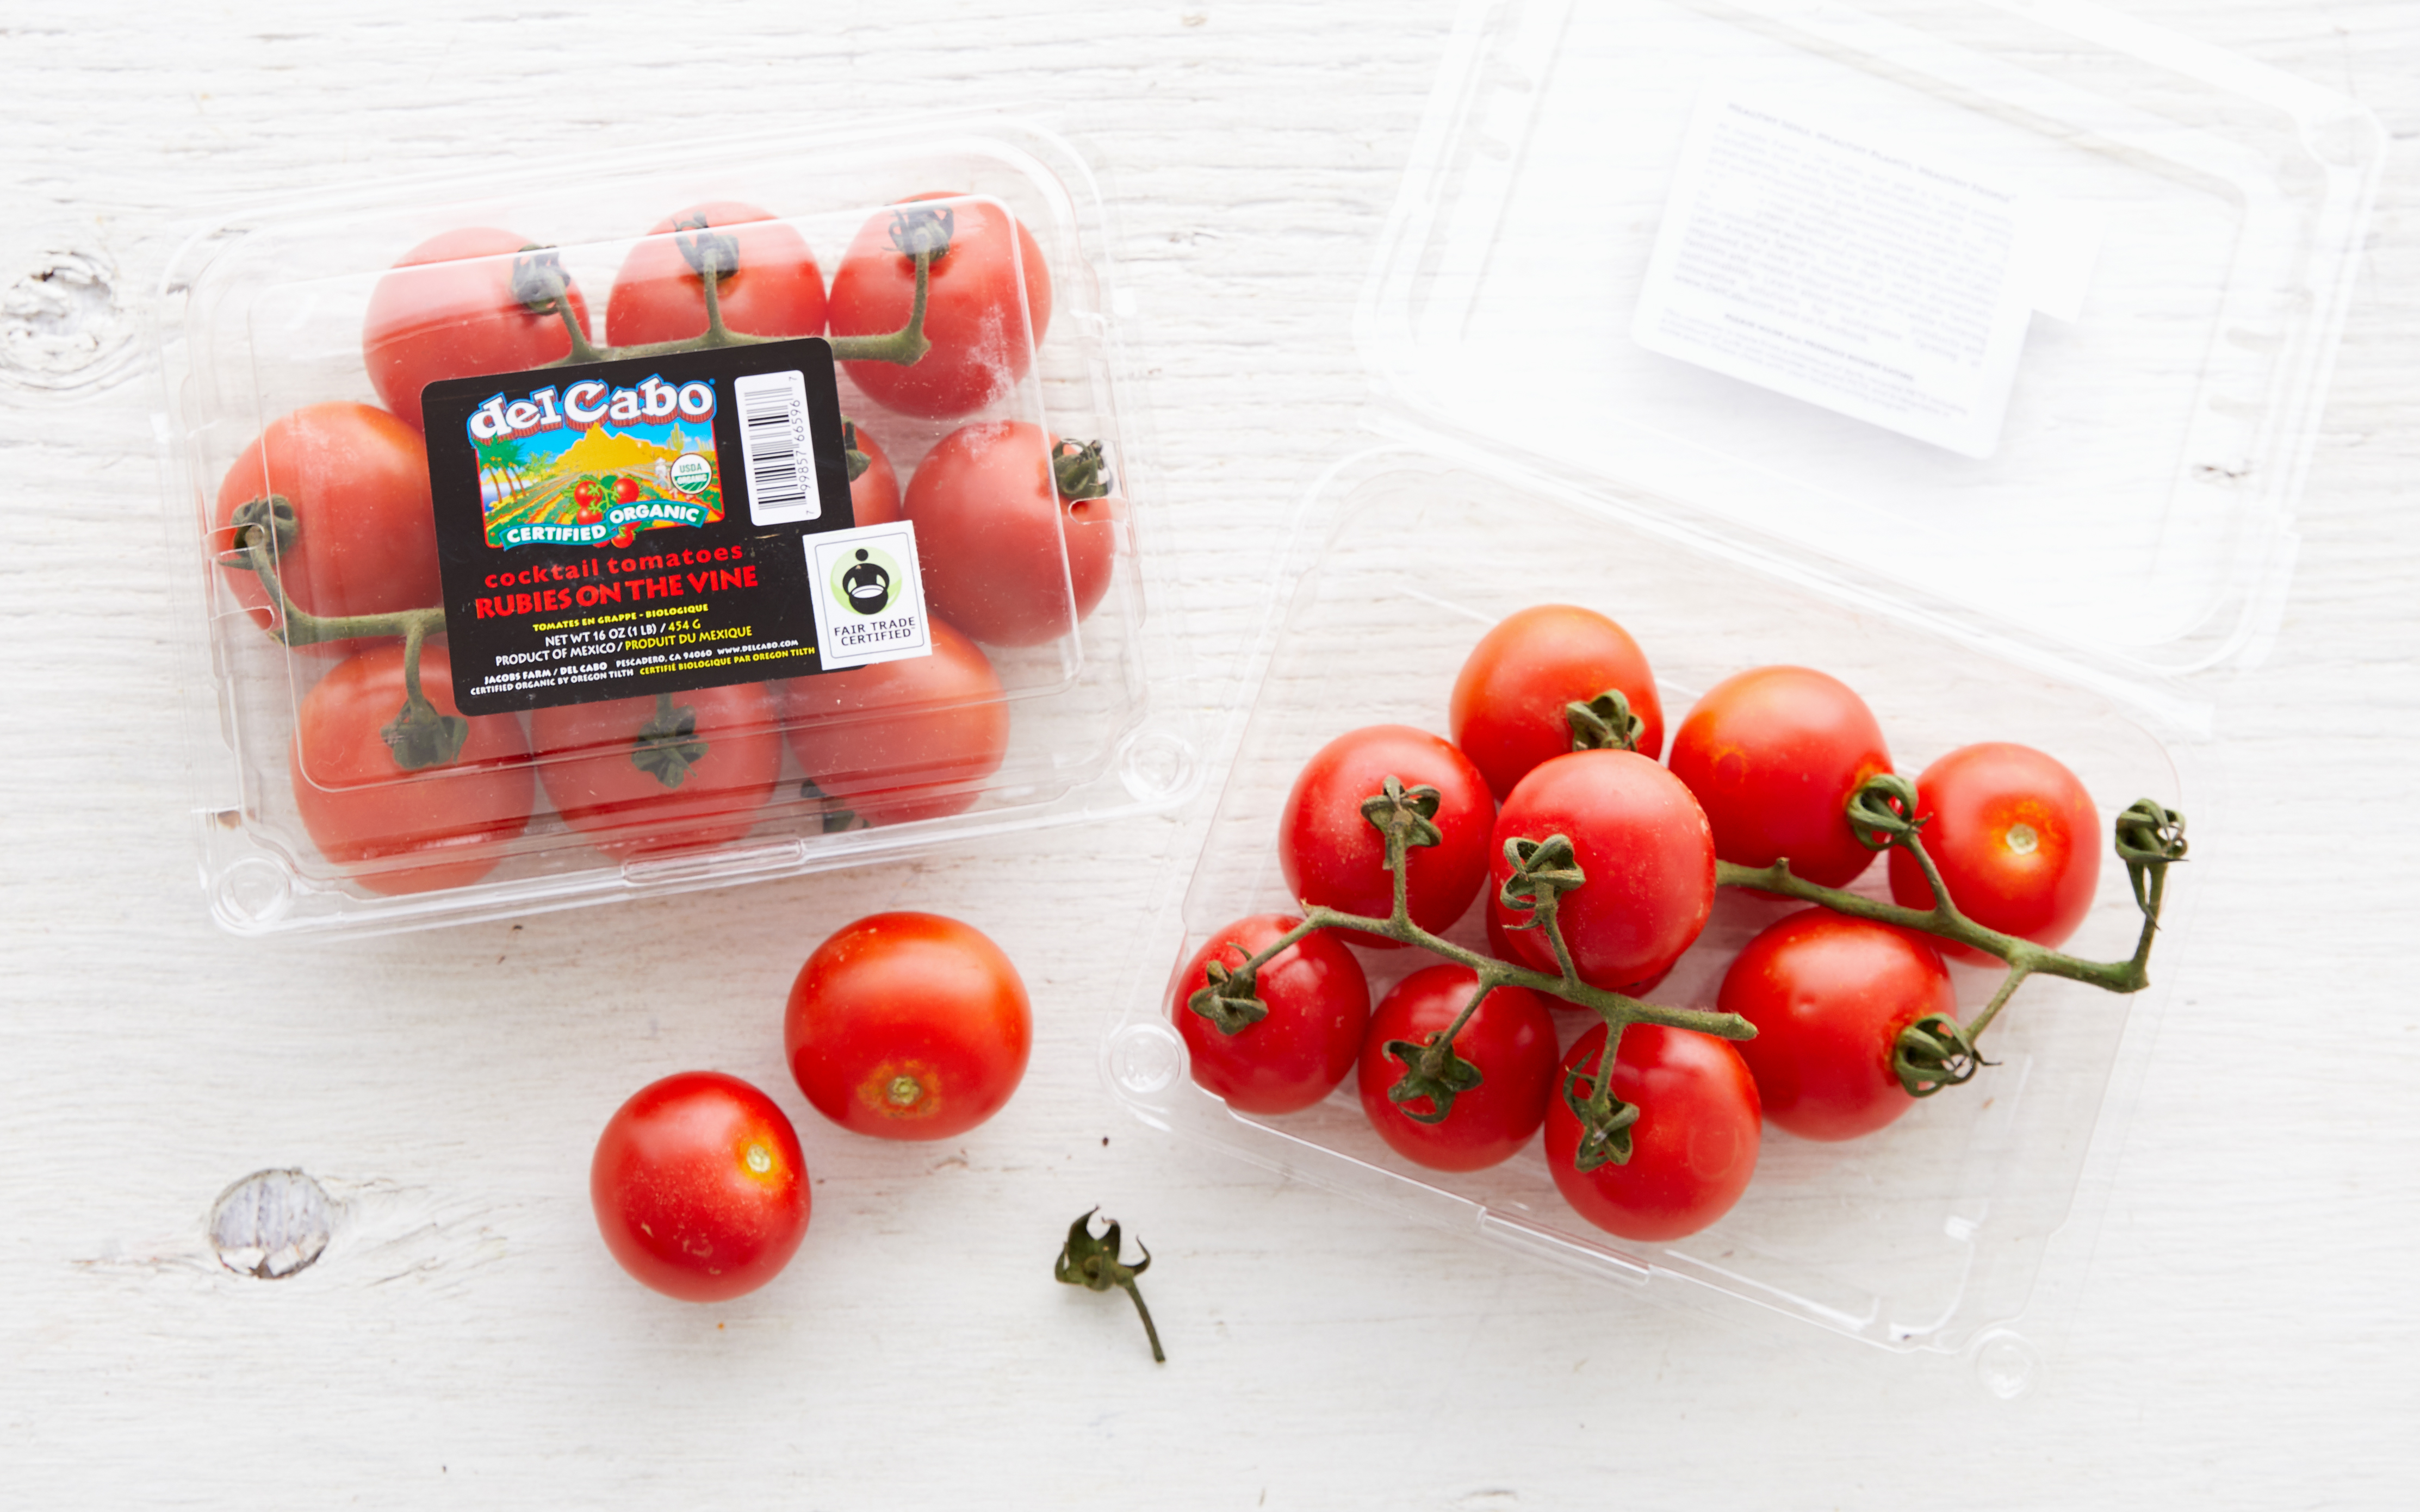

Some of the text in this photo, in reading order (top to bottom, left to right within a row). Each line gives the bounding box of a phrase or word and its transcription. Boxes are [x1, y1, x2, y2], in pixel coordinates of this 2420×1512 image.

[789, 399, 805, 442] 66596
[679, 462, 702, 474] USDA
[795, 449, 811, 491] 99857
[507, 497, 699, 542] CERTIFIED ORGANIC
[485, 545, 742, 588] cocktail tomatoes
[475, 565, 758, 619] RUBIES ON THE VINE
[532, 619, 580, 631] TOMATES
[581, 617, 595, 626] EN
[597, 612, 637, 624] GRAPPE
[646, 603, 708, 618] BIOLOGIQUE
[545, 634, 568, 647] NET
[569, 631, 591, 643] WT
[593, 630, 606, 640] 16
[608, 627, 625, 639] OZ
[627, 626, 637, 637] (1
[640, 623, 656, 635] LB)
[668, 620, 689, 631] 454
[692, 618, 701, 629] G
[834, 617, 915, 636] FAIR TRADE
[484, 672, 520, 685] JACOBS
[522, 669, 551, 680] FARM
[560, 665, 578, 675] DEL
[579, 662, 607, 673] CABO
[616, 655, 667, 668] PESCADERO,
[668, 653, 681, 661] CA
[683, 649, 712, 659] 94060
[717, 639, 798, 655] WWW.DELCABO.COM
[495, 650, 550, 666] PRODUCT
[552, 648, 567, 659] OF
[570, 642, 616, 657] MEXICO
[625, 634, 676, 650] PRODUIT
[679, 632, 696, 644] DU
[699, 625, 752, 642] MEXIQUE
[470, 646, 815, 695] CERTIFIED ORGANIC BY OREGON TILTH CERTIFIÉ BIOLOGIQUE PAR OREGON TILTH
